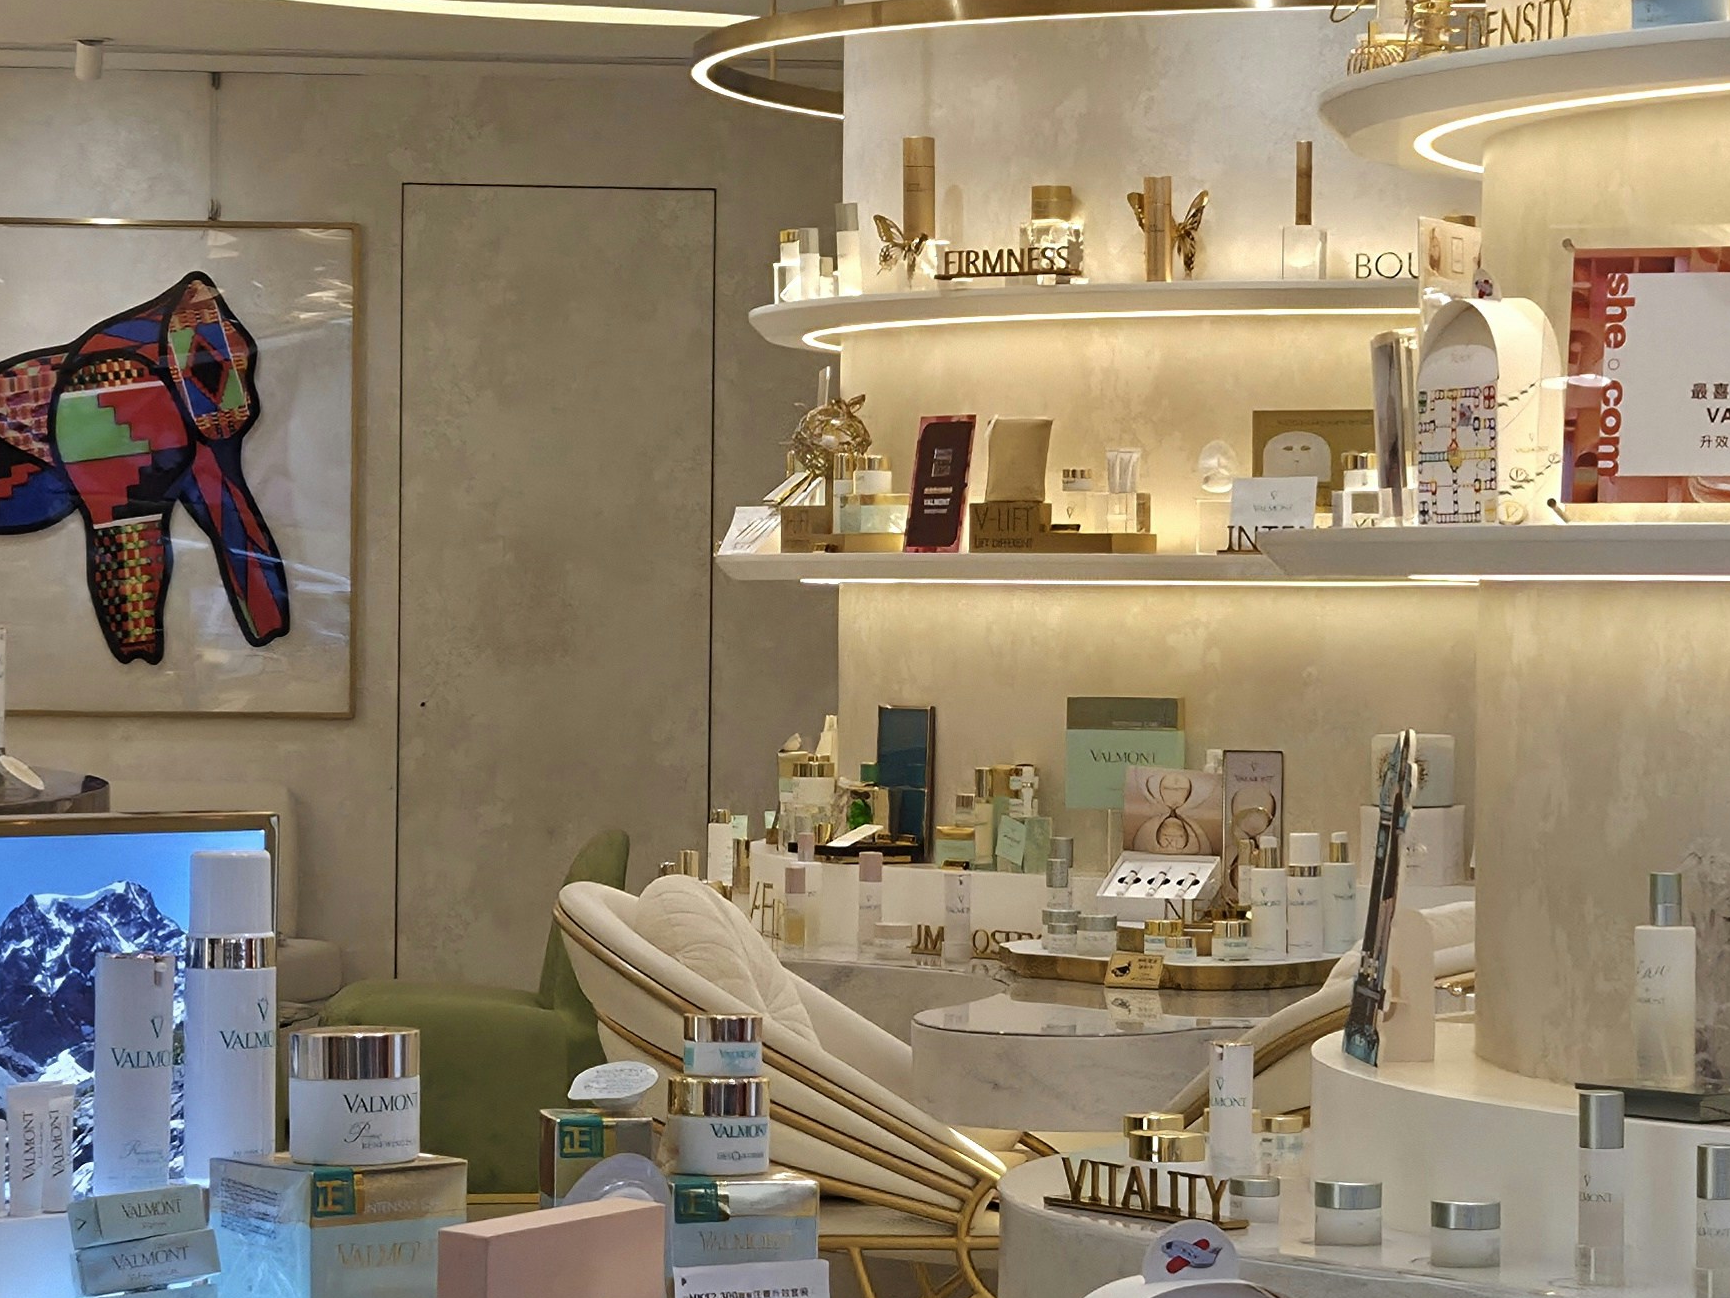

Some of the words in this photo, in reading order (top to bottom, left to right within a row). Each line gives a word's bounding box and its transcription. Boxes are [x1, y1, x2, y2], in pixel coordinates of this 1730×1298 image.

[944, 246, 1070, 276] FIRMNESS
[22, 1111, 34, 1181] VALMONT
[49, 1108, 64, 1178] VALMONT
[121, 1197, 183, 1220] VALMONT
[1061, 1156, 1229, 1225] VITALITY
[111, 1246, 190, 1270] VALMONT
